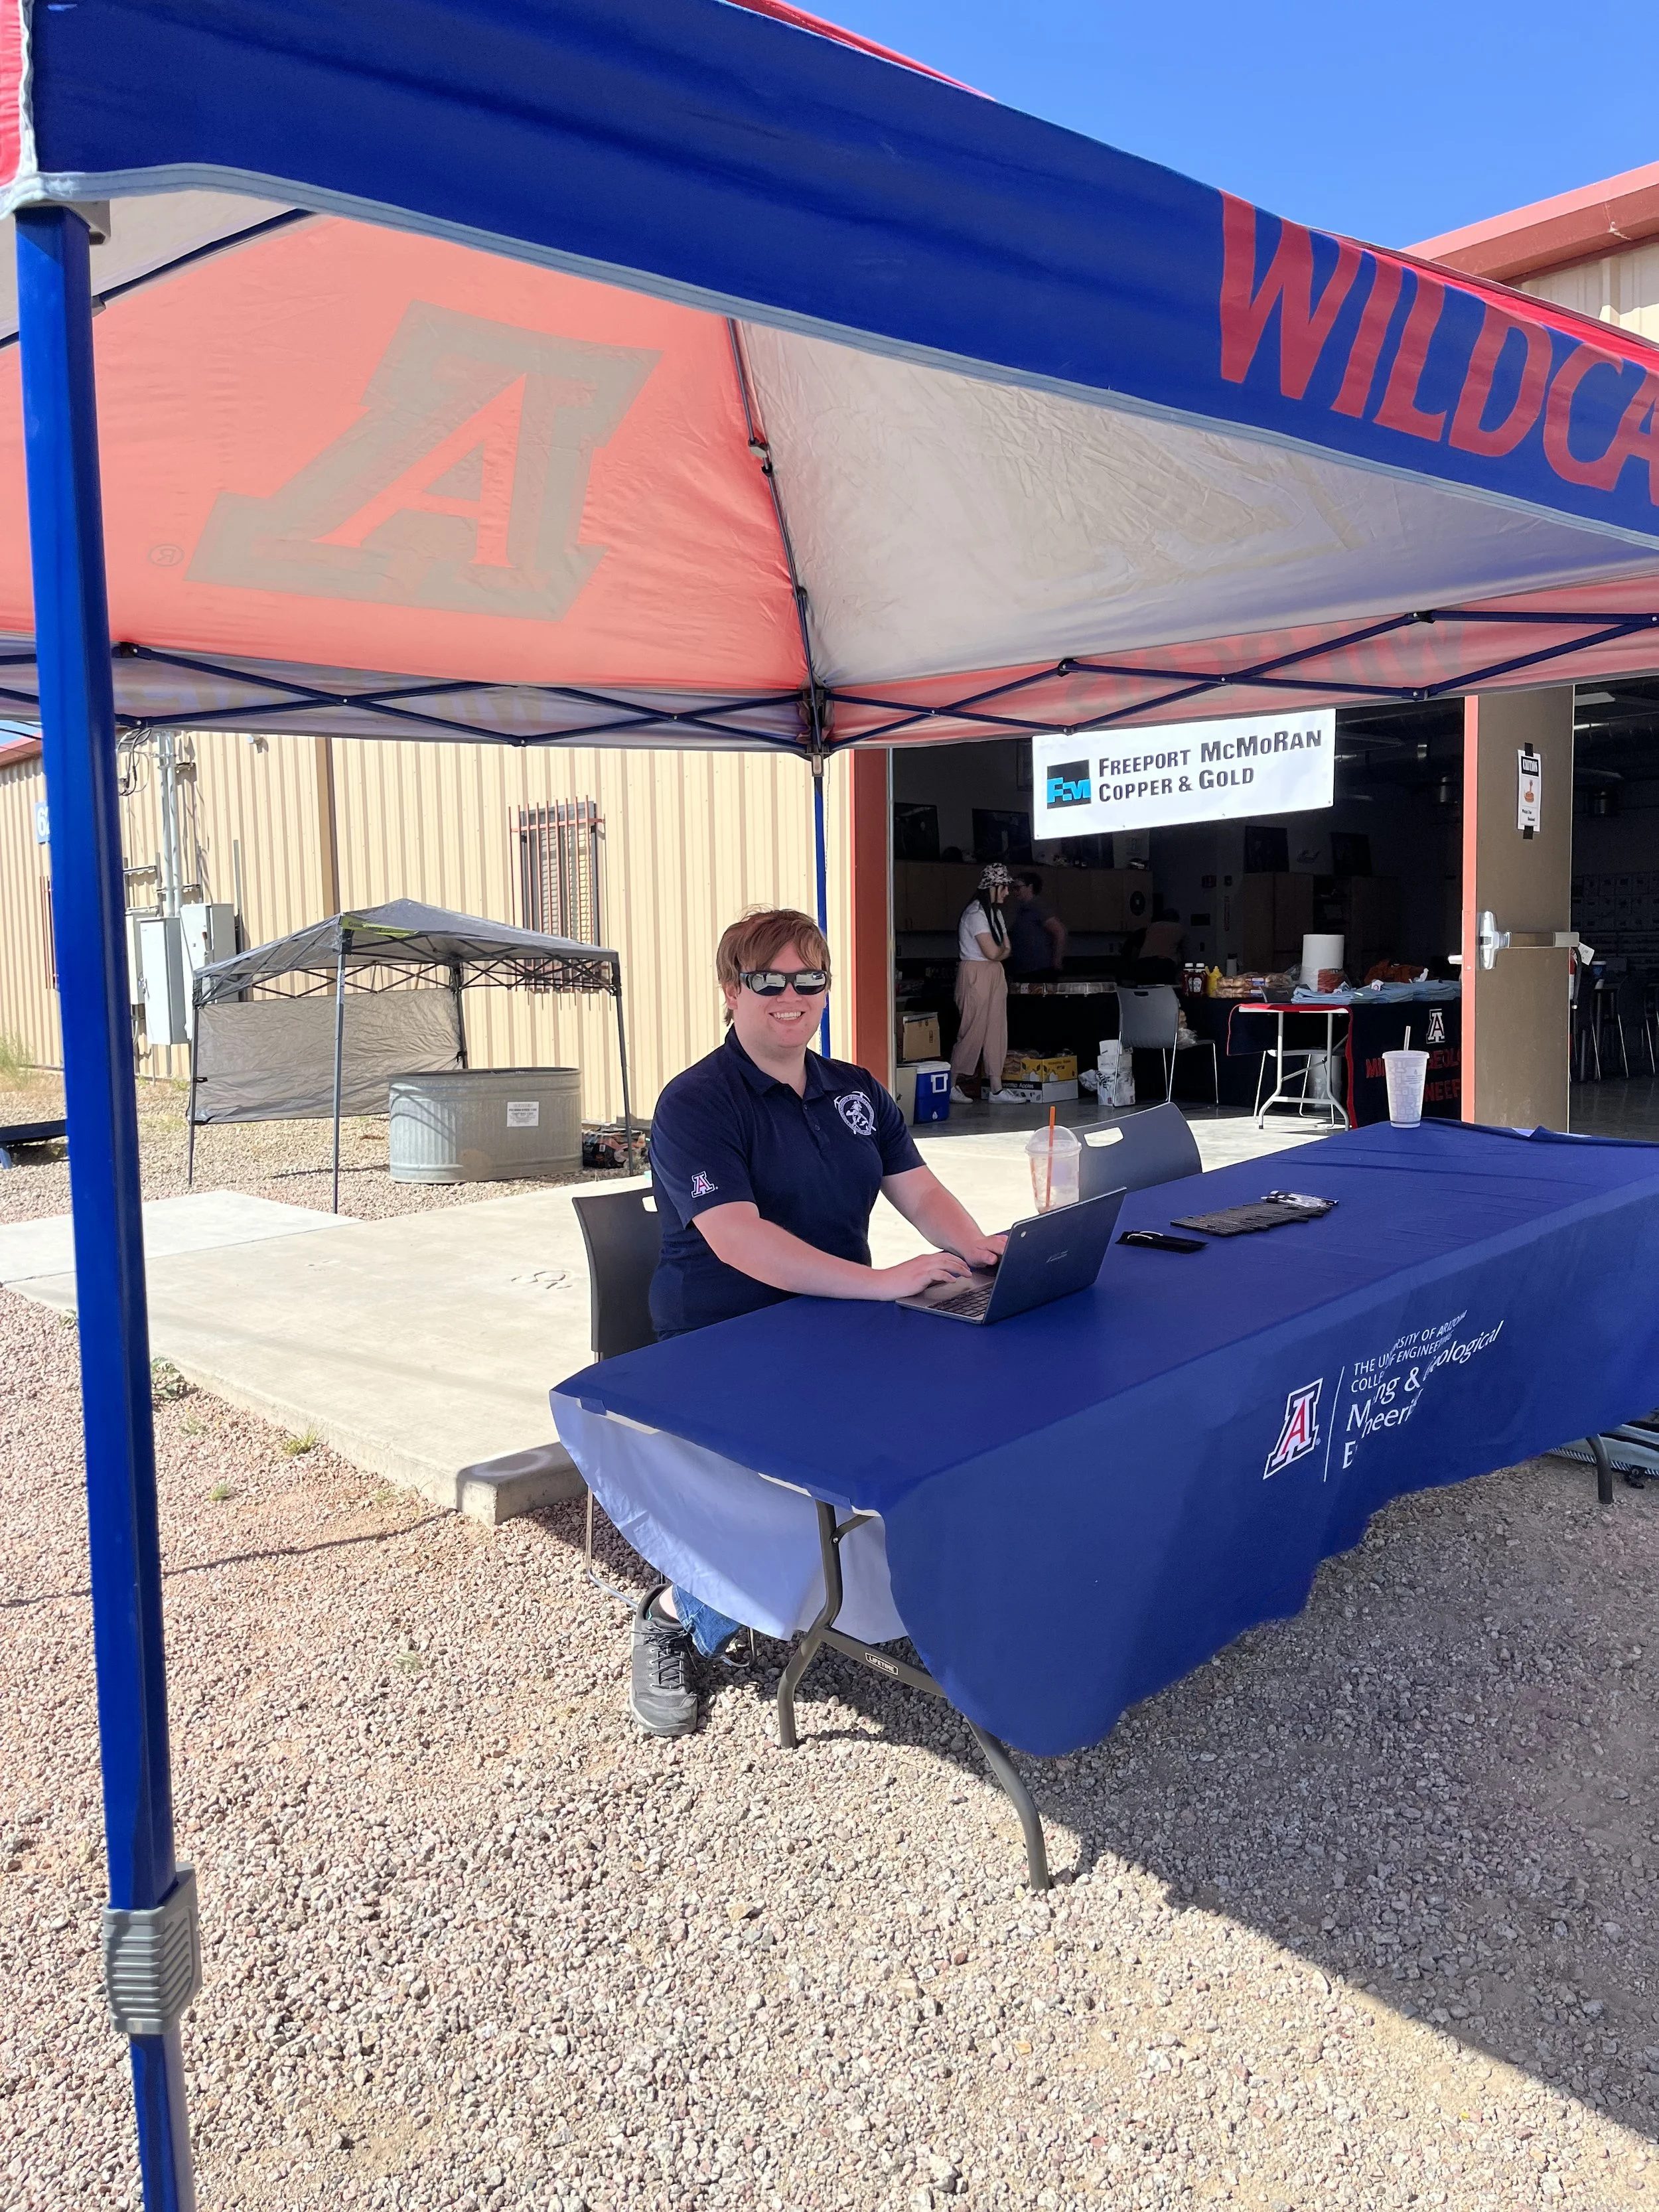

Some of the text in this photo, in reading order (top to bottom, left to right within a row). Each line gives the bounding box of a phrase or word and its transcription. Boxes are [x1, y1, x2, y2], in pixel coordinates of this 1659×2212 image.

[1099, 768, 1254, 802] COPPER & GOLD
[1426, 1009, 1445, 1044] A
[691, 1171, 715, 1198] A
[1354, 1359, 1376, 1376] THE
[1421, 1327, 1437, 1341] OF
[1436, 1309, 1467, 1337] ARIZO
[1404, 1366, 1420, 1392] &
[1263, 1377, 1323, 1480] A
[869, 1655, 895, 1672] LIFETIME
